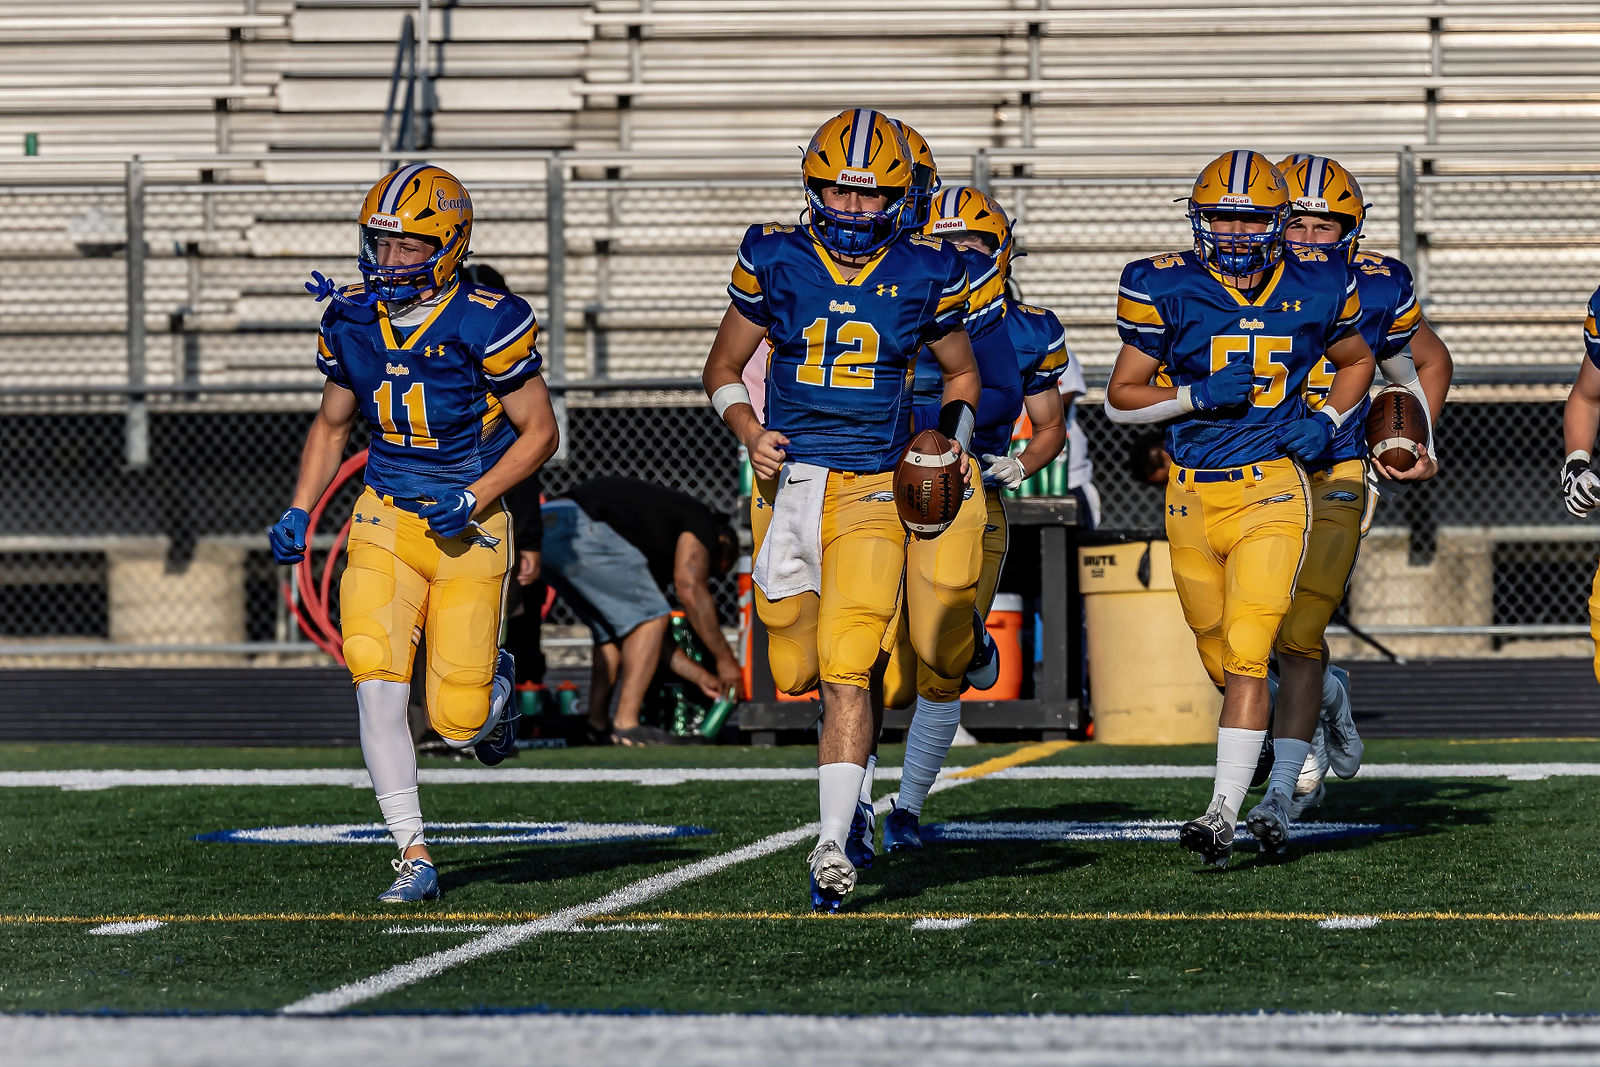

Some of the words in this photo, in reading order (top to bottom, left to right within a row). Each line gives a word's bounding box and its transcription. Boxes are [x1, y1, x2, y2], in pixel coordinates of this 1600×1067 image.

[841, 173, 874, 185] Riddell
[1296, 199, 1326, 209] Ridell
[369, 216, 399, 229] Riddell
[935, 220, 963, 230] Riddell
[467, 288, 506, 310] 11
[829, 299, 857, 315] Eagles
[1239, 317, 1265, 331] Eagles
[796, 317, 881, 390] 12
[386, 362, 410, 377] Eagles
[1209, 334, 1294, 409] 55
[373, 380, 440, 450] 11
[920, 479, 933, 517] Wilson
